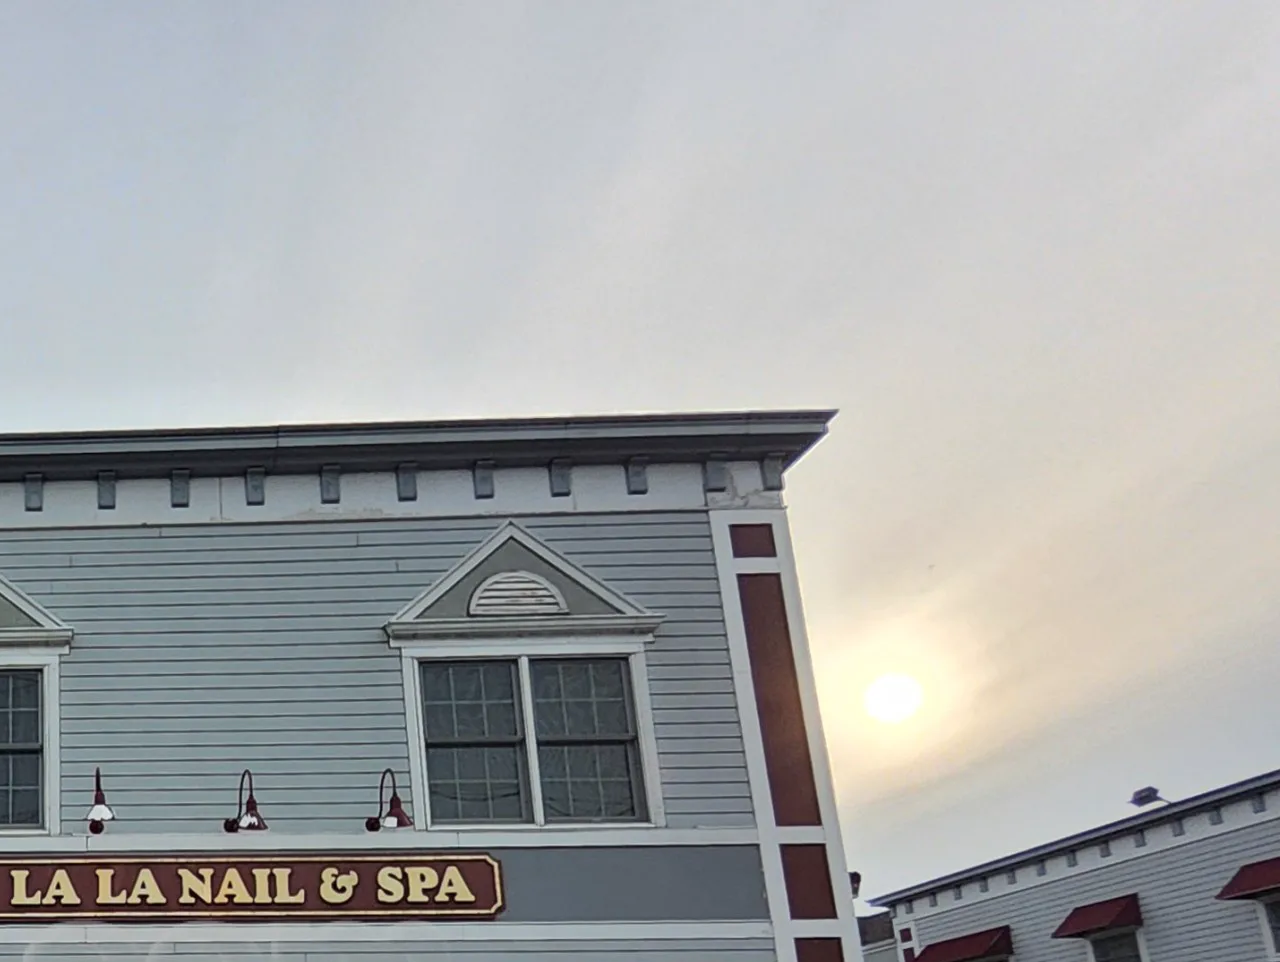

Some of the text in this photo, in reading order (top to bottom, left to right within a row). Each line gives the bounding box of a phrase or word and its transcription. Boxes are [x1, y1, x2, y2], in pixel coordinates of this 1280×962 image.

[9, 864, 477, 906] LA LA NAIL & SPA
